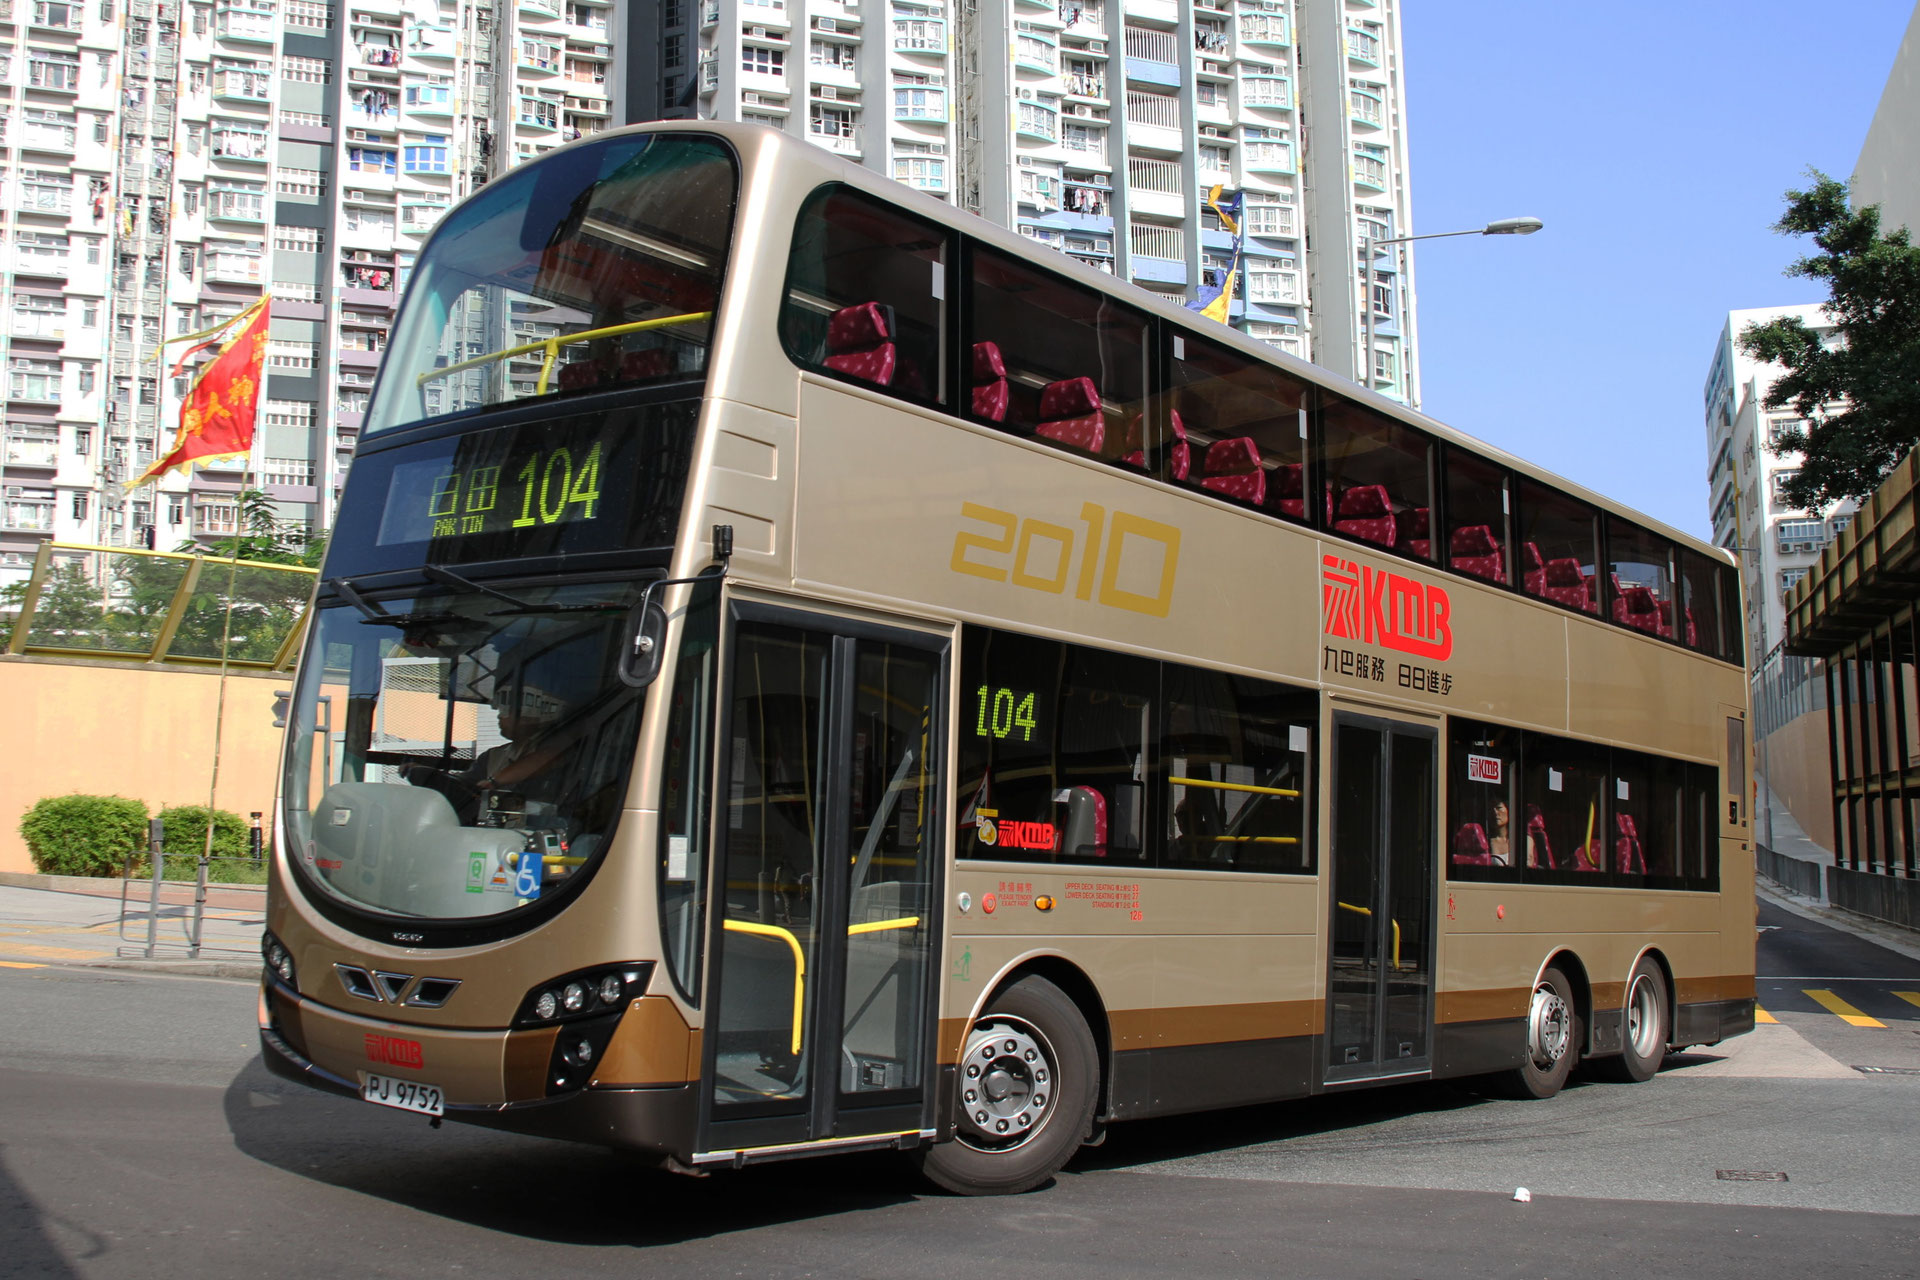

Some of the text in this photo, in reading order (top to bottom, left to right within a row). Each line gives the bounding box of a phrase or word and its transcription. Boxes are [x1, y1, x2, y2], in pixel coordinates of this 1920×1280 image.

[512, 441, 601, 528] 104
[432, 517, 458, 537] PAK
[951, 501, 1182, 619] 2010
[1324, 645, 1453, 695] 九巴服務 日日進步
[976, 685, 1036, 741] 104
[1014, 820, 1056, 850] KMB
[1065, 882, 1080, 890] UPPER
[1129, 910, 1143, 921] 126
[370, 1076, 440, 1112] PJ 9752
